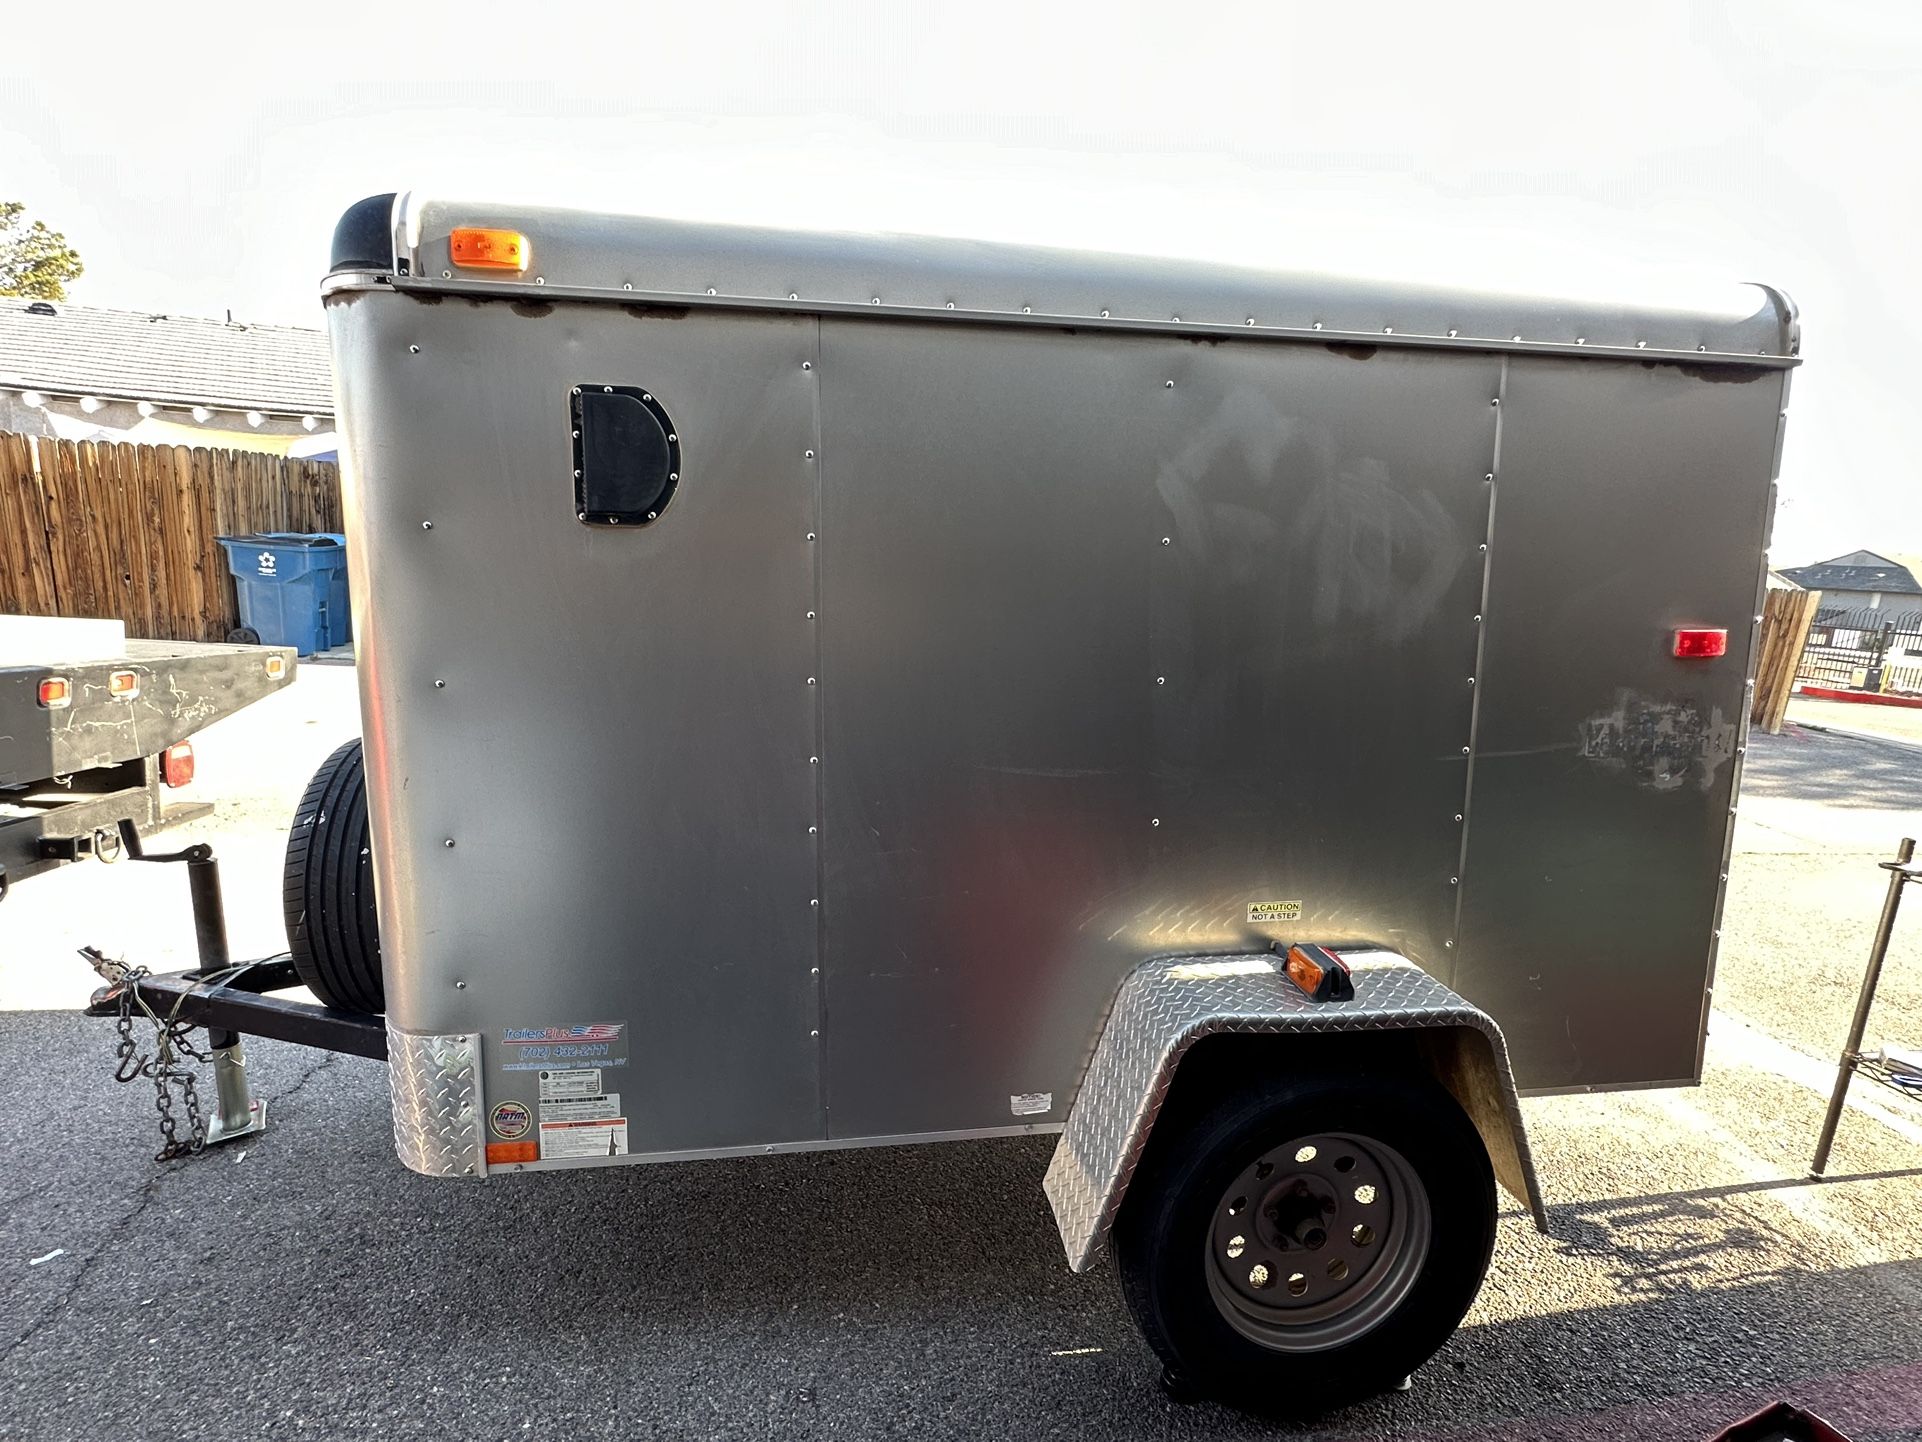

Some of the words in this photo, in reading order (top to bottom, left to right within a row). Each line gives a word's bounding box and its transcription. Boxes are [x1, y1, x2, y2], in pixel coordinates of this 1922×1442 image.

[504, 1027, 569, 1040] TrailersPlus
[520, 1046, 550, 1060] (702)
[553, 1043, 608, 1057] 432-2111
